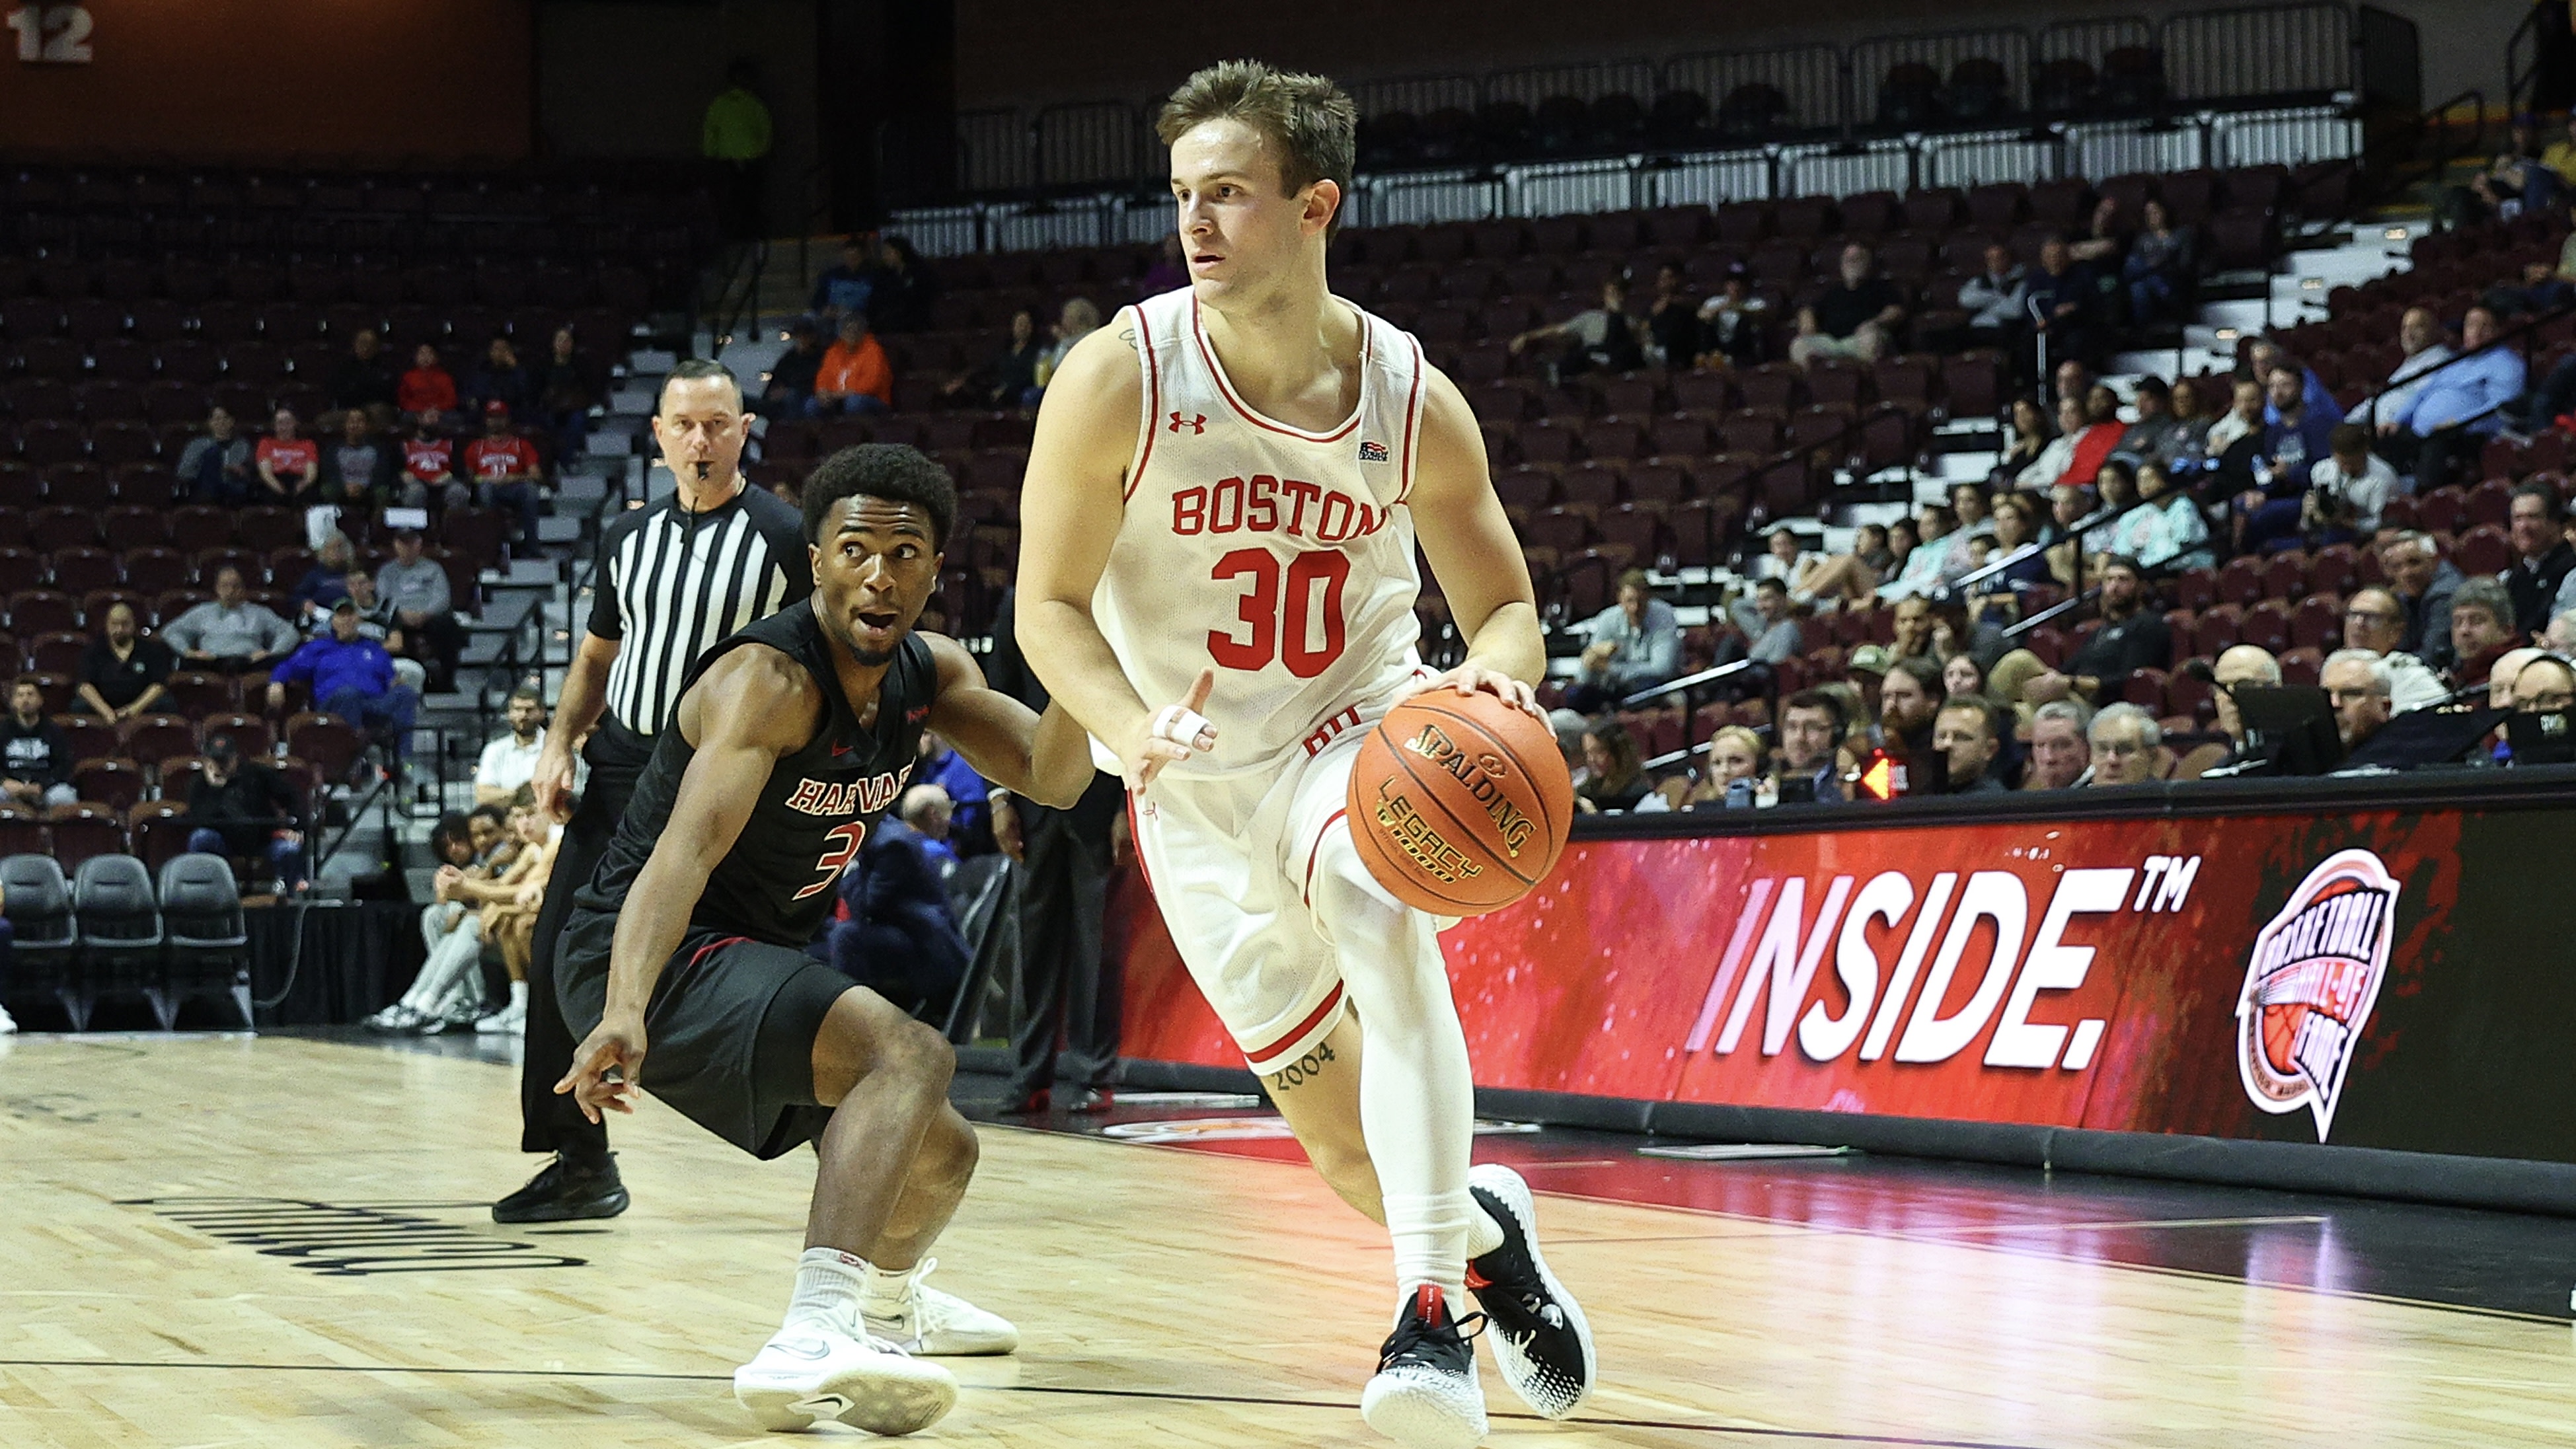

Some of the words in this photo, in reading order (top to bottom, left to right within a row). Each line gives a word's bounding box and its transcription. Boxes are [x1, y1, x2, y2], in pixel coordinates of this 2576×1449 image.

[7, 5, 93, 62] 12
[1172, 474, 1387, 541] BOSTON
[1207, 546, 1351, 679] 30
[1379, 775, 1484, 879] LEGACY
[1404, 724, 1537, 858] SPALDING
[792, 820, 866, 901] 3
[2259, 891, 2384, 978] BASKETBALL
[1271, 1041, 1336, 1091] 2004
[2295, 1010, 2349, 1102] FAME
